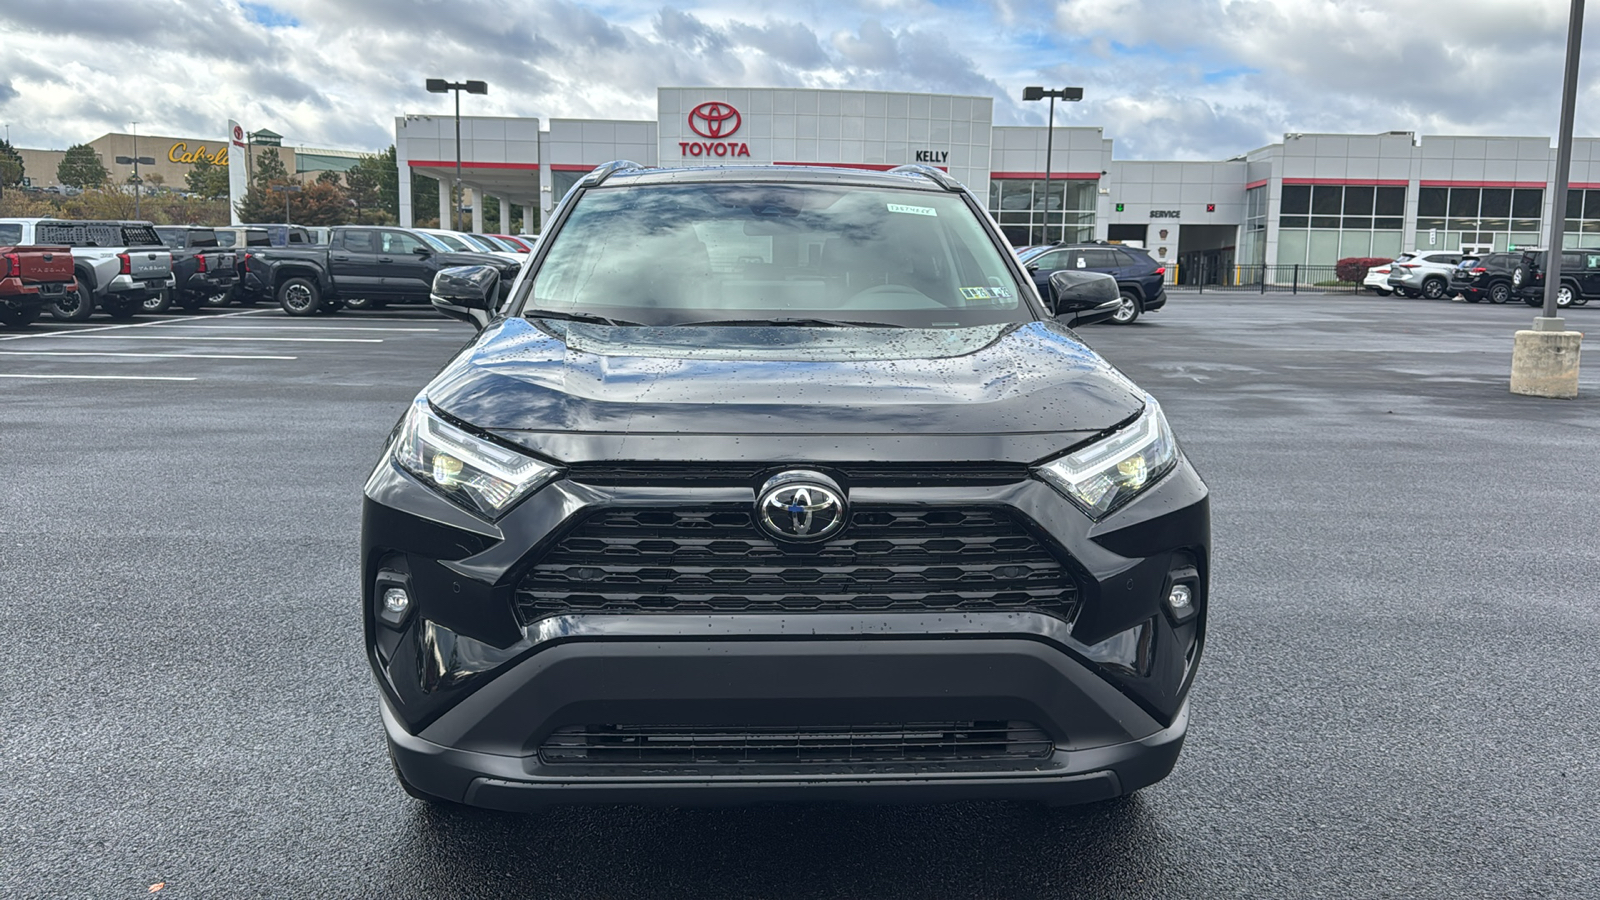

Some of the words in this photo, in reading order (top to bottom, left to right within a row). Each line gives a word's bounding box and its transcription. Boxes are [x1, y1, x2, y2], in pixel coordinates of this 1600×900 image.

[678, 141, 751, 157] TOYOTA
[915, 150, 949, 163] KELLY
[1149, 210, 1181, 219] SERVICE
